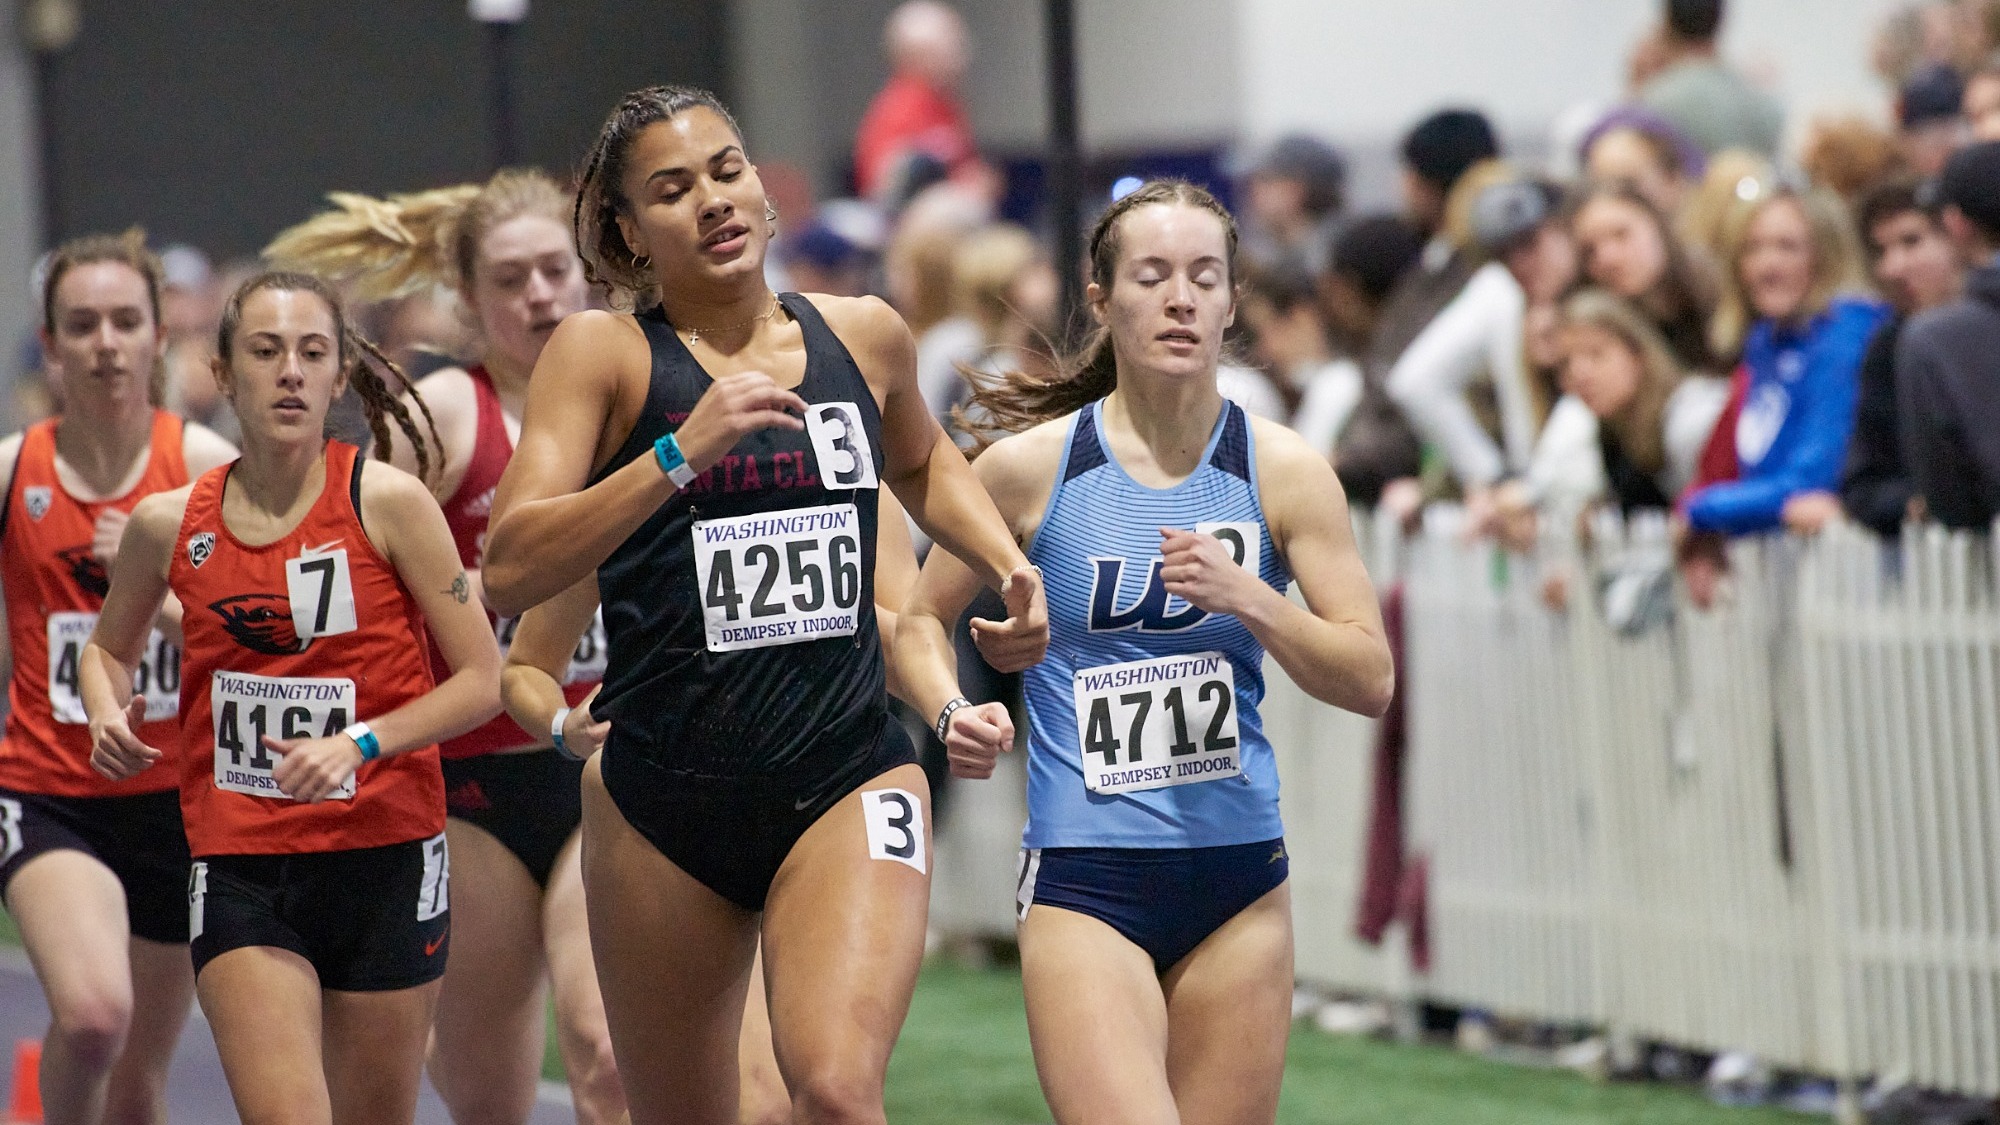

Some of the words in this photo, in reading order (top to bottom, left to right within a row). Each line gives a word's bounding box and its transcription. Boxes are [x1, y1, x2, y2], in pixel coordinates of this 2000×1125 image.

[677, 454, 762, 494] NTA
[773, 450, 822, 488] CL
[820, 407, 863, 484] 3
[705, 511, 850, 543] WASHINGTON
[300, 558, 335, 633] 7
[706, 535, 858, 621] 4256
[722, 621, 797, 642] DEMPSEY
[802, 616, 852, 632] INDOOR
[220, 677, 344, 700] WASHINGTON
[1084, 657, 1221, 692] WASHINGTON
[1085, 680, 1237, 766] 4712
[1100, 766, 1172, 787] DEMPSEY
[1177, 757, 1232, 777] INDOOR
[879, 792, 916, 859] 3
[430, 840, 447, 914] 7
